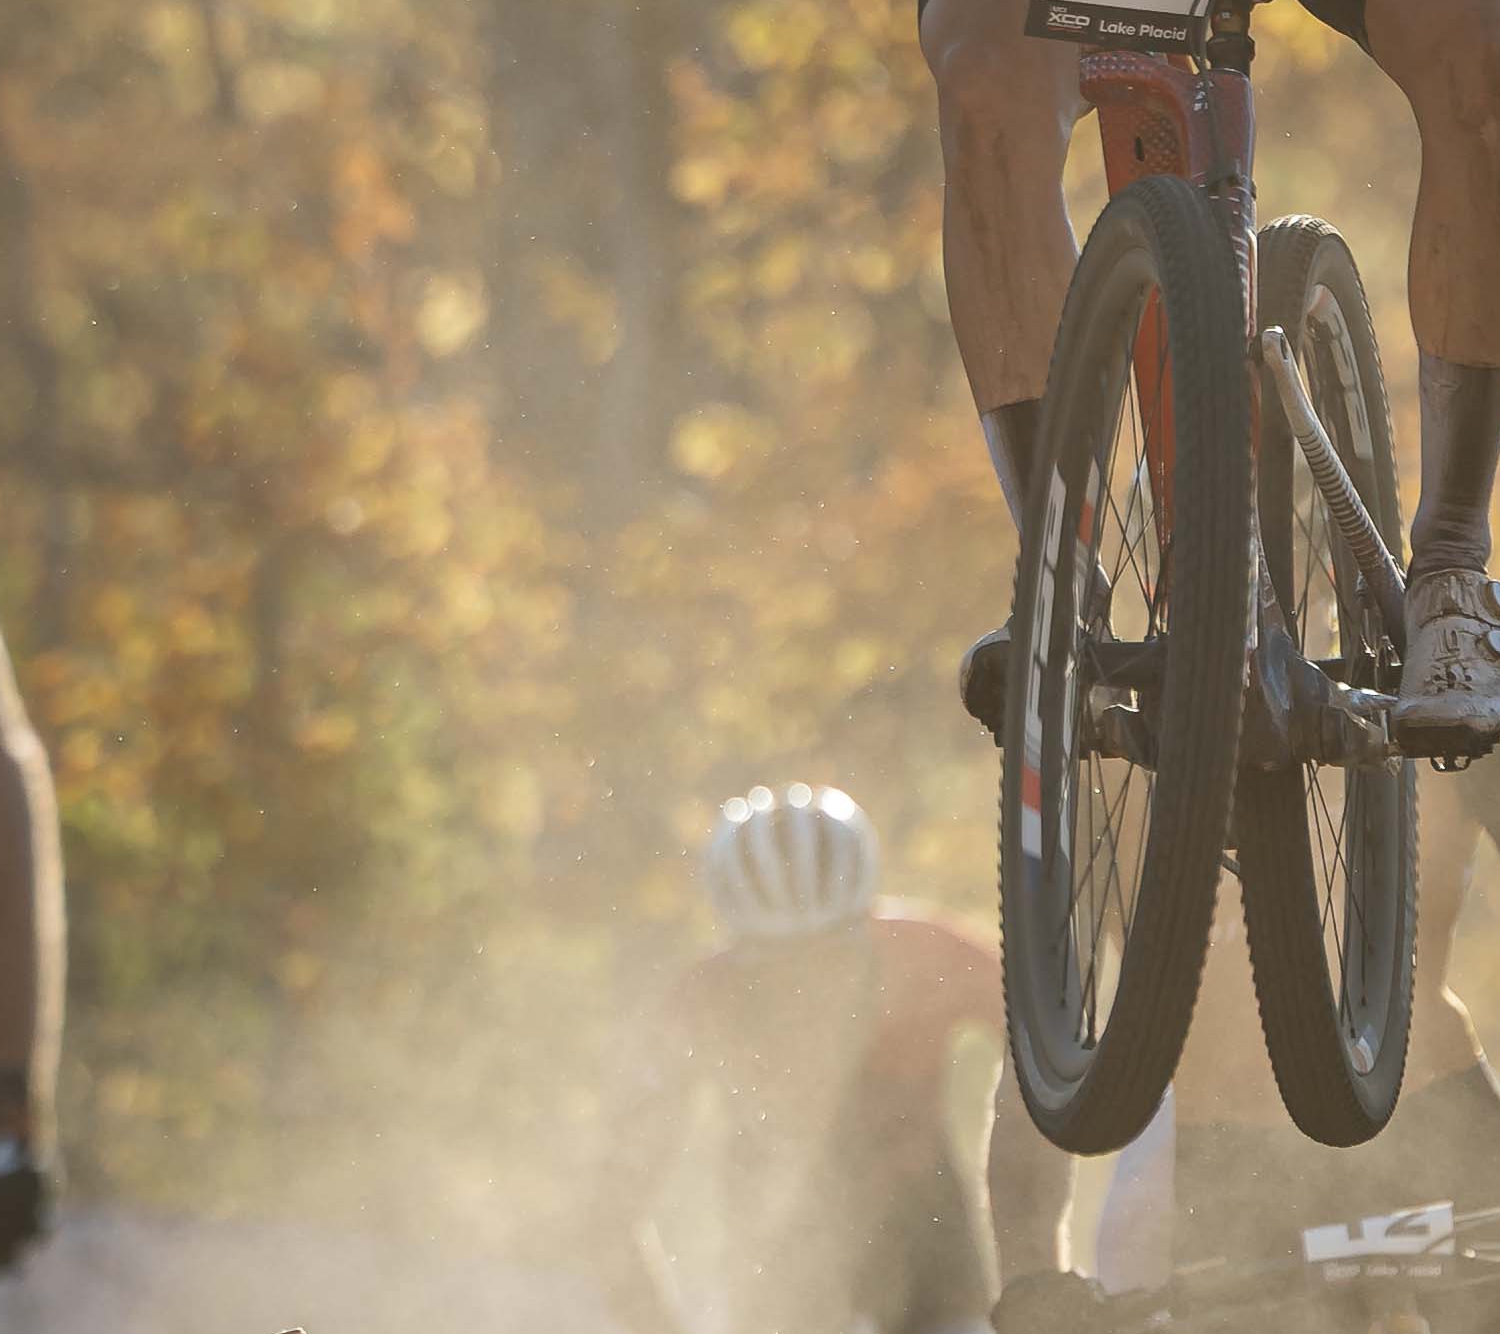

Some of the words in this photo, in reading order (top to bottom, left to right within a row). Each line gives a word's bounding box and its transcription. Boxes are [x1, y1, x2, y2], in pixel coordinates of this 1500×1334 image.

[1048, 12, 1091, 27] XCO
[1099, 19, 1136, 36] Lake
[1139, 23, 1187, 41] Placid
